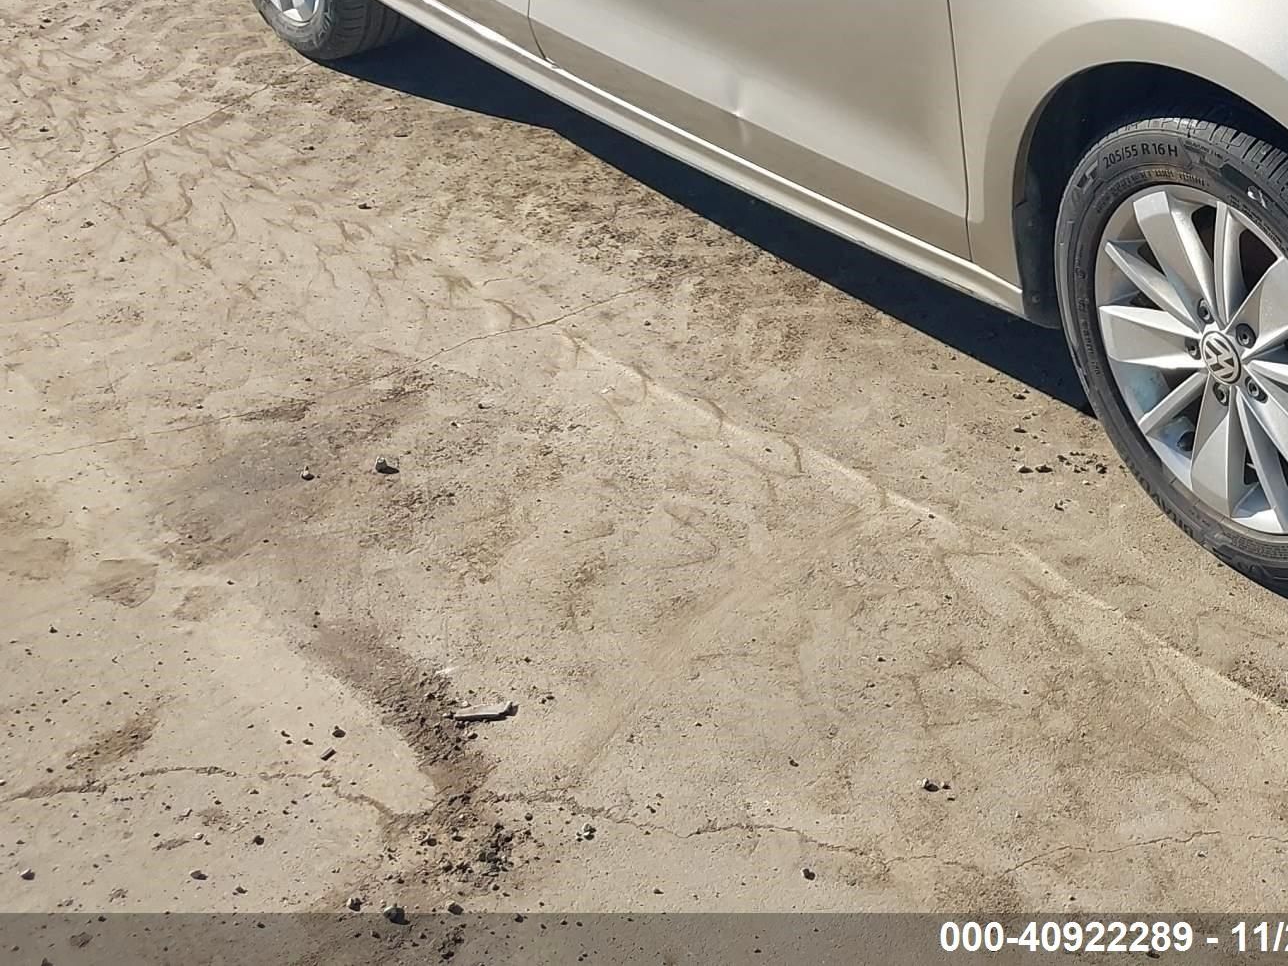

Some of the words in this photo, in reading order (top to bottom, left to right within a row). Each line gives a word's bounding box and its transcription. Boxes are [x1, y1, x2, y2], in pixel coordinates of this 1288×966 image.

[1103, 143, 1139, 168] 205/55
[1141, 142, 1151, 155] R
[1151, 143, 1166, 156] 16
[1168, 144, 1178, 157] H
